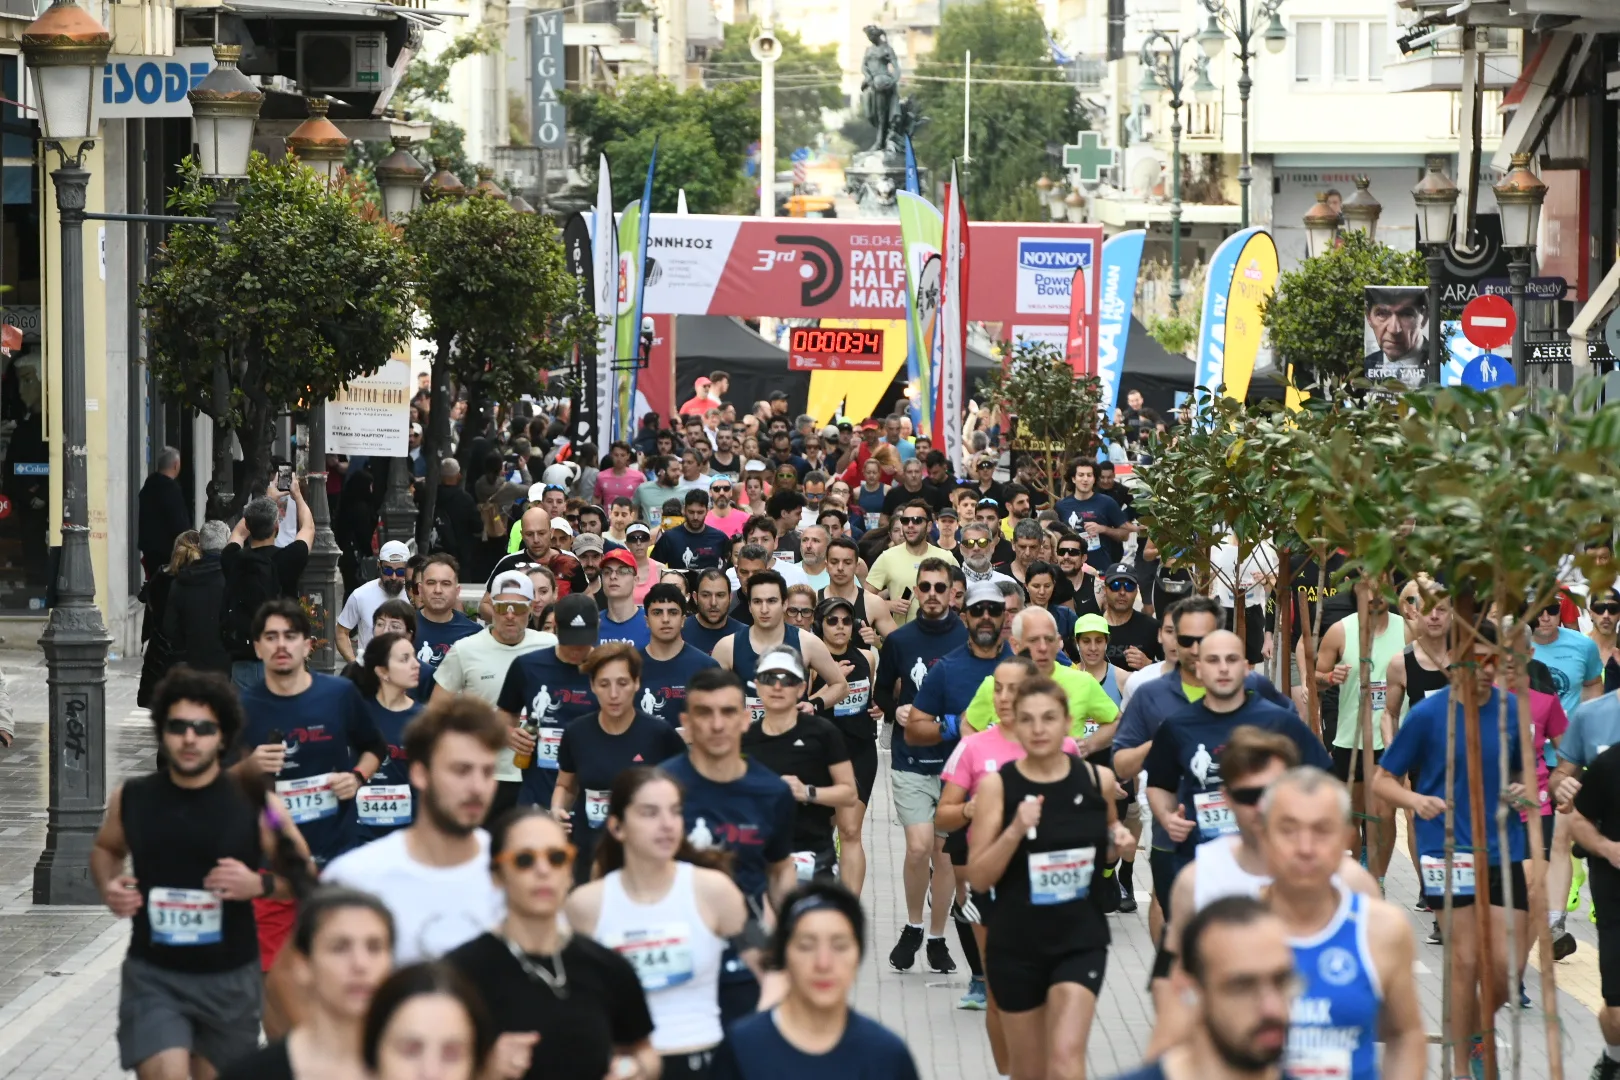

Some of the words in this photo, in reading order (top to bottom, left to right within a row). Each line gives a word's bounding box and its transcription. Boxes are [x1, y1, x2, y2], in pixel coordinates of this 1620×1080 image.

[537, 15, 559, 143] MIGATO
[752, 249, 797, 272] 3rd
[850, 250, 906, 269] PATR
[1023, 251, 1087, 265] NOYNOY
[850, 270, 905, 288] HALF
[1035, 273, 1073, 286] Powe
[1440, 283, 1479, 301] ARA
[793, 331, 879, 353] 00:00:34
[284, 793, 323, 810] 3175
[363, 801, 398, 812] 3444
[1039, 870, 1080, 887] 3005
[1429, 869, 1461, 882] 331
[156, 909, 203, 926] 3104
